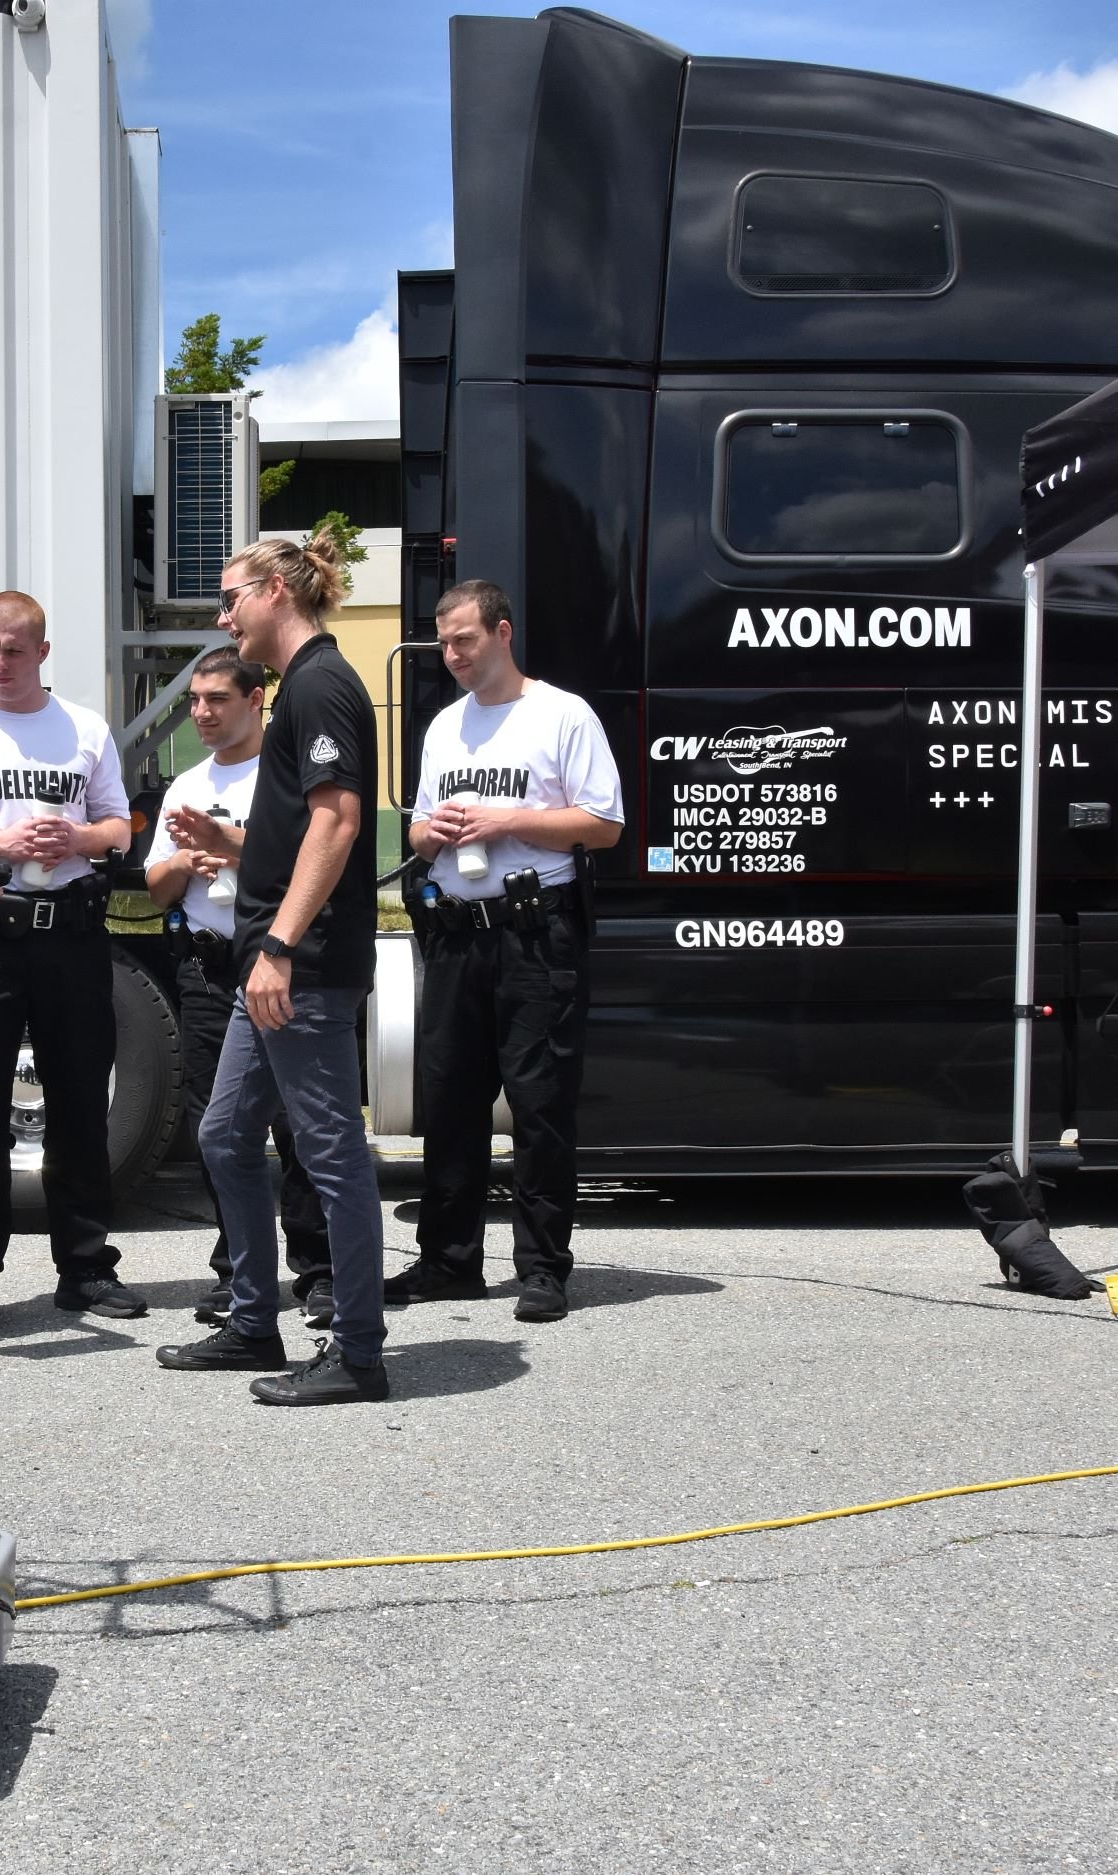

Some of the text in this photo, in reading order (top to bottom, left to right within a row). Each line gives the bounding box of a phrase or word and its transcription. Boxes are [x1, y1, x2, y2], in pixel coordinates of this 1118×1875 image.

[727, 606, 971, 648] AXON.COM
[928, 700, 1016, 725] AXON
[649, 736, 707, 761] CW
[708, 737, 761, 751] Leasing
[781, 737, 847, 750] Transport
[928, 743, 1090, 768] SPECAL
[673, 784, 837, 803] USDOT 573816
[673, 807, 827, 826] IMCA 29032-B
[673, 831, 797, 850] ICC 279857
[674, 854, 806, 873] KYU 133236
[675, 920, 844, 948] GN964489
